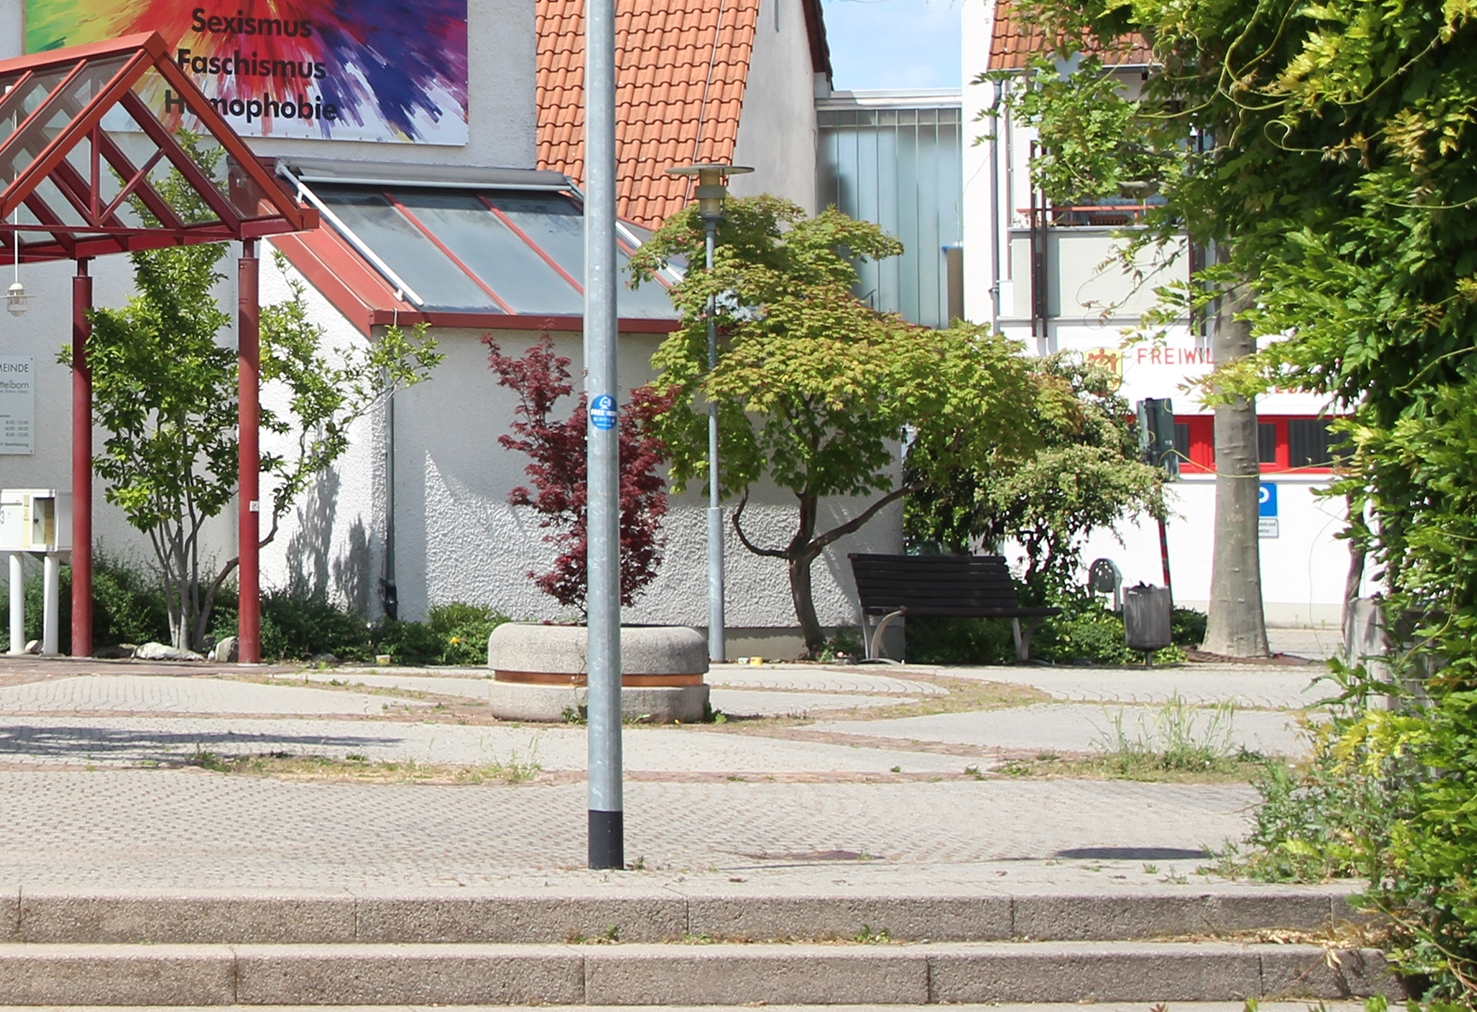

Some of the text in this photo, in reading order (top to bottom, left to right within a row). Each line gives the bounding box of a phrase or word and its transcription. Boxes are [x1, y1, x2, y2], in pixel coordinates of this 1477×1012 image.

[191, 7, 313, 38] Sexismus
[177, 48, 328, 80] Faschismus
[165, 89, 339, 124] Hmophobie
[1136, 346, 1215, 366] FREIWIL
